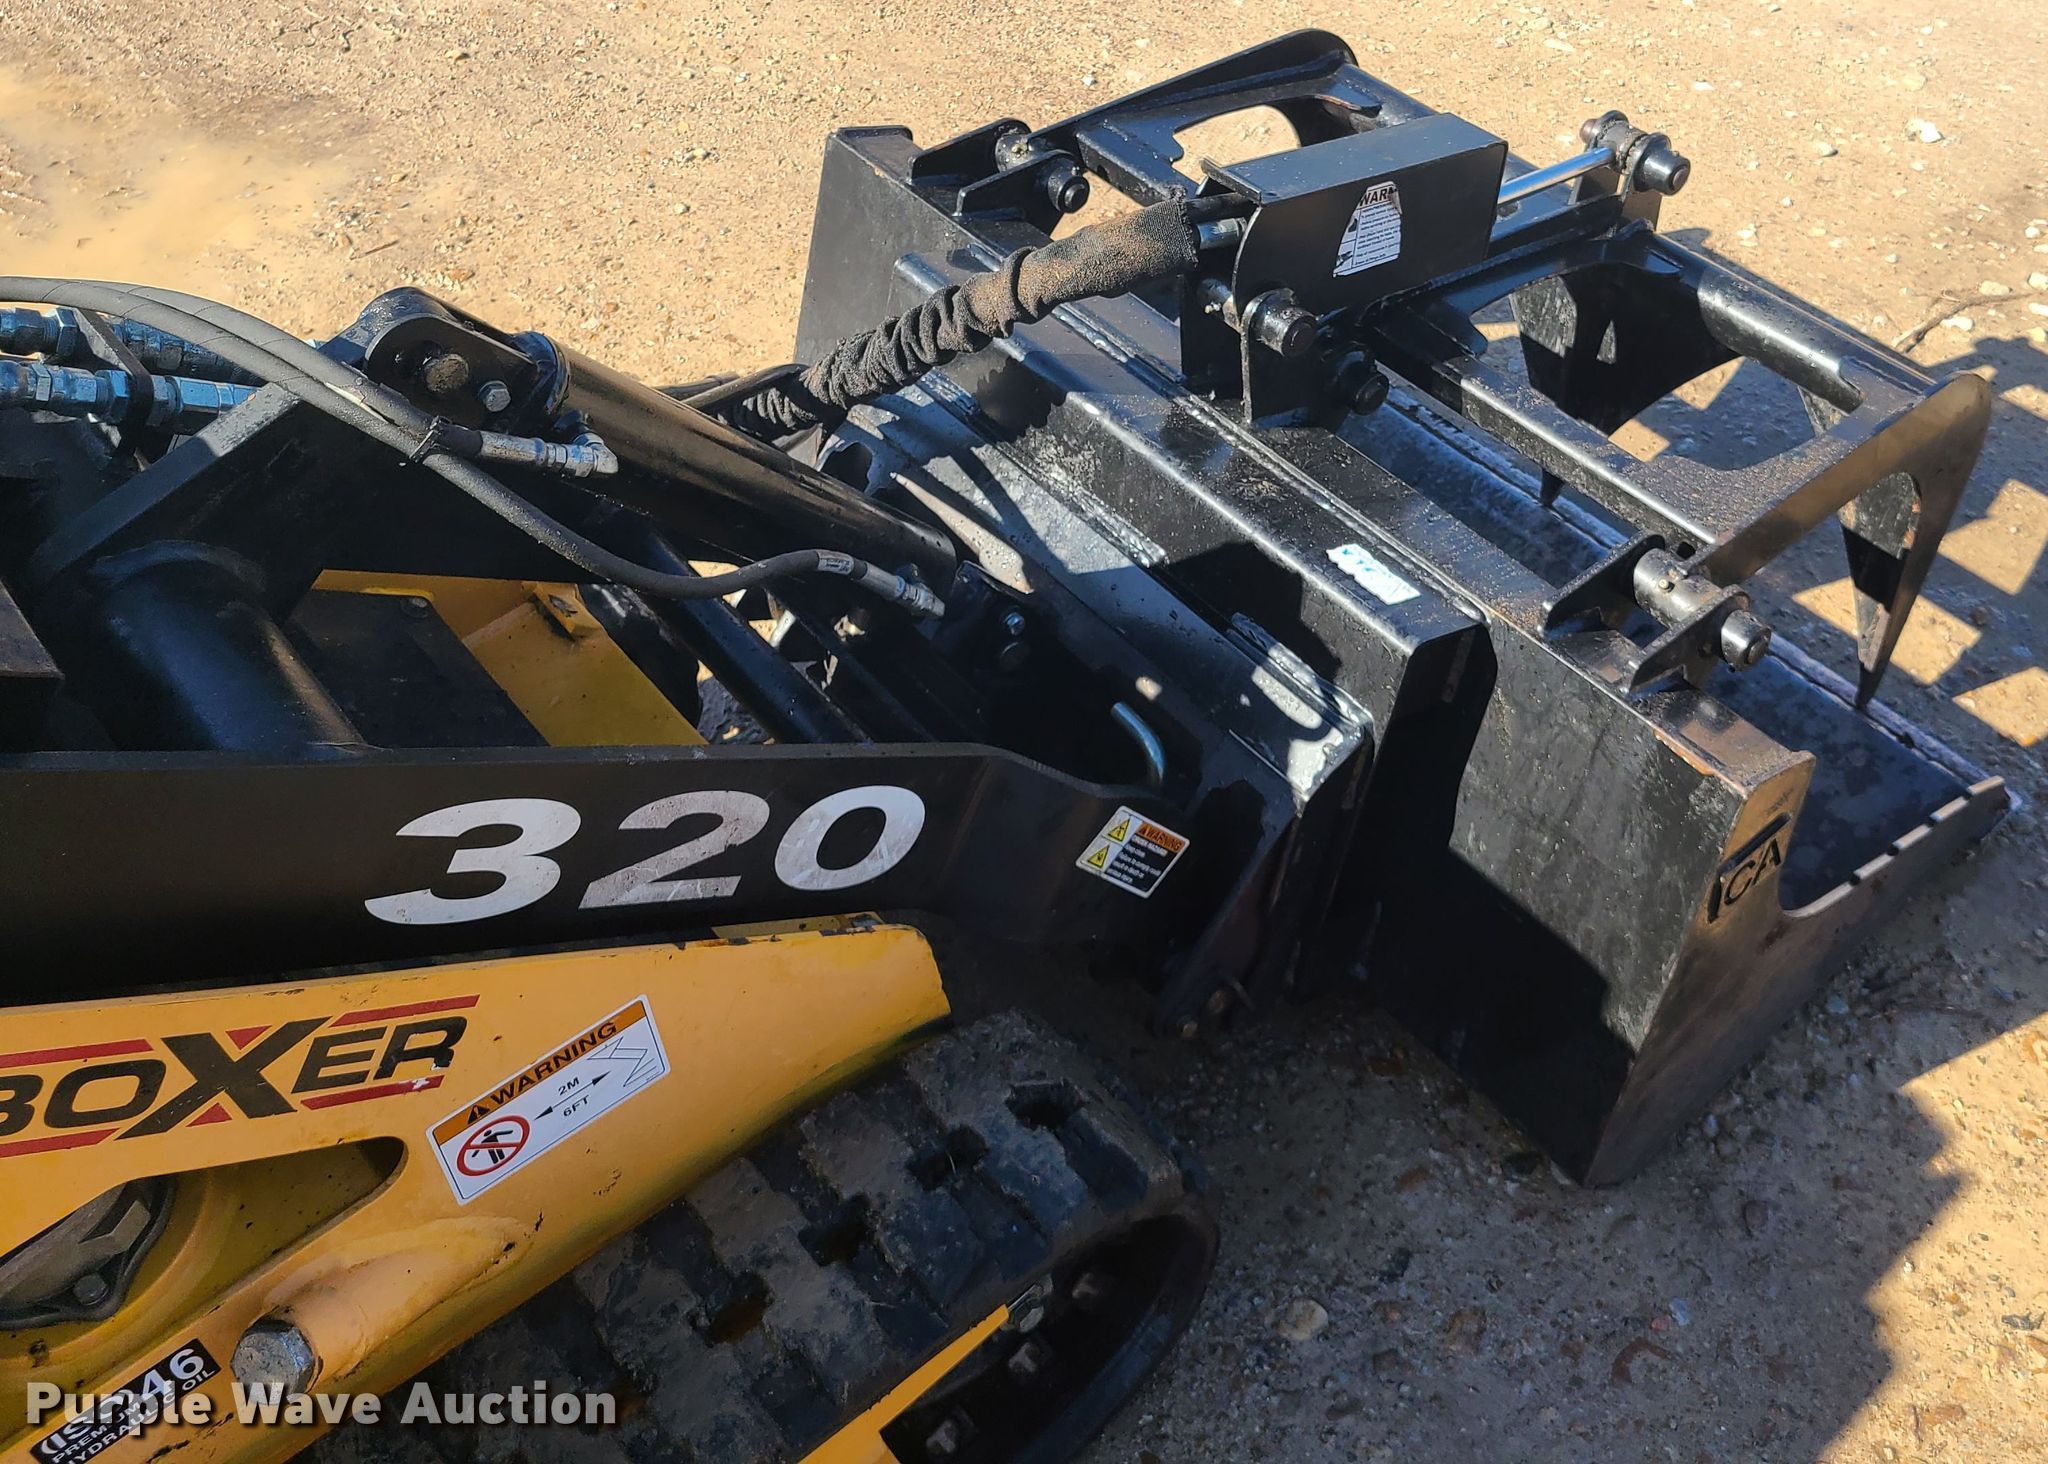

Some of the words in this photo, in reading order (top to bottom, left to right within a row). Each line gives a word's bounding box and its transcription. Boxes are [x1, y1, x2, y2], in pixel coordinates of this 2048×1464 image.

[364, 785, 926, 925] 320
[1145, 823, 1181, 851] WARNING
[0, 1016, 468, 1140] BOXER
[490, 1021, 618, 1105] WARNING
[558, 1076, 580, 1096] 2M
[563, 1095, 590, 1117] 6FT
[140, 1348, 205, 1401] 46
[52, 1402, 141, 1463] PREMUM
[68, 1392, 175, 1464] YDRAULC
[182, 1368, 216, 1392] OIL
